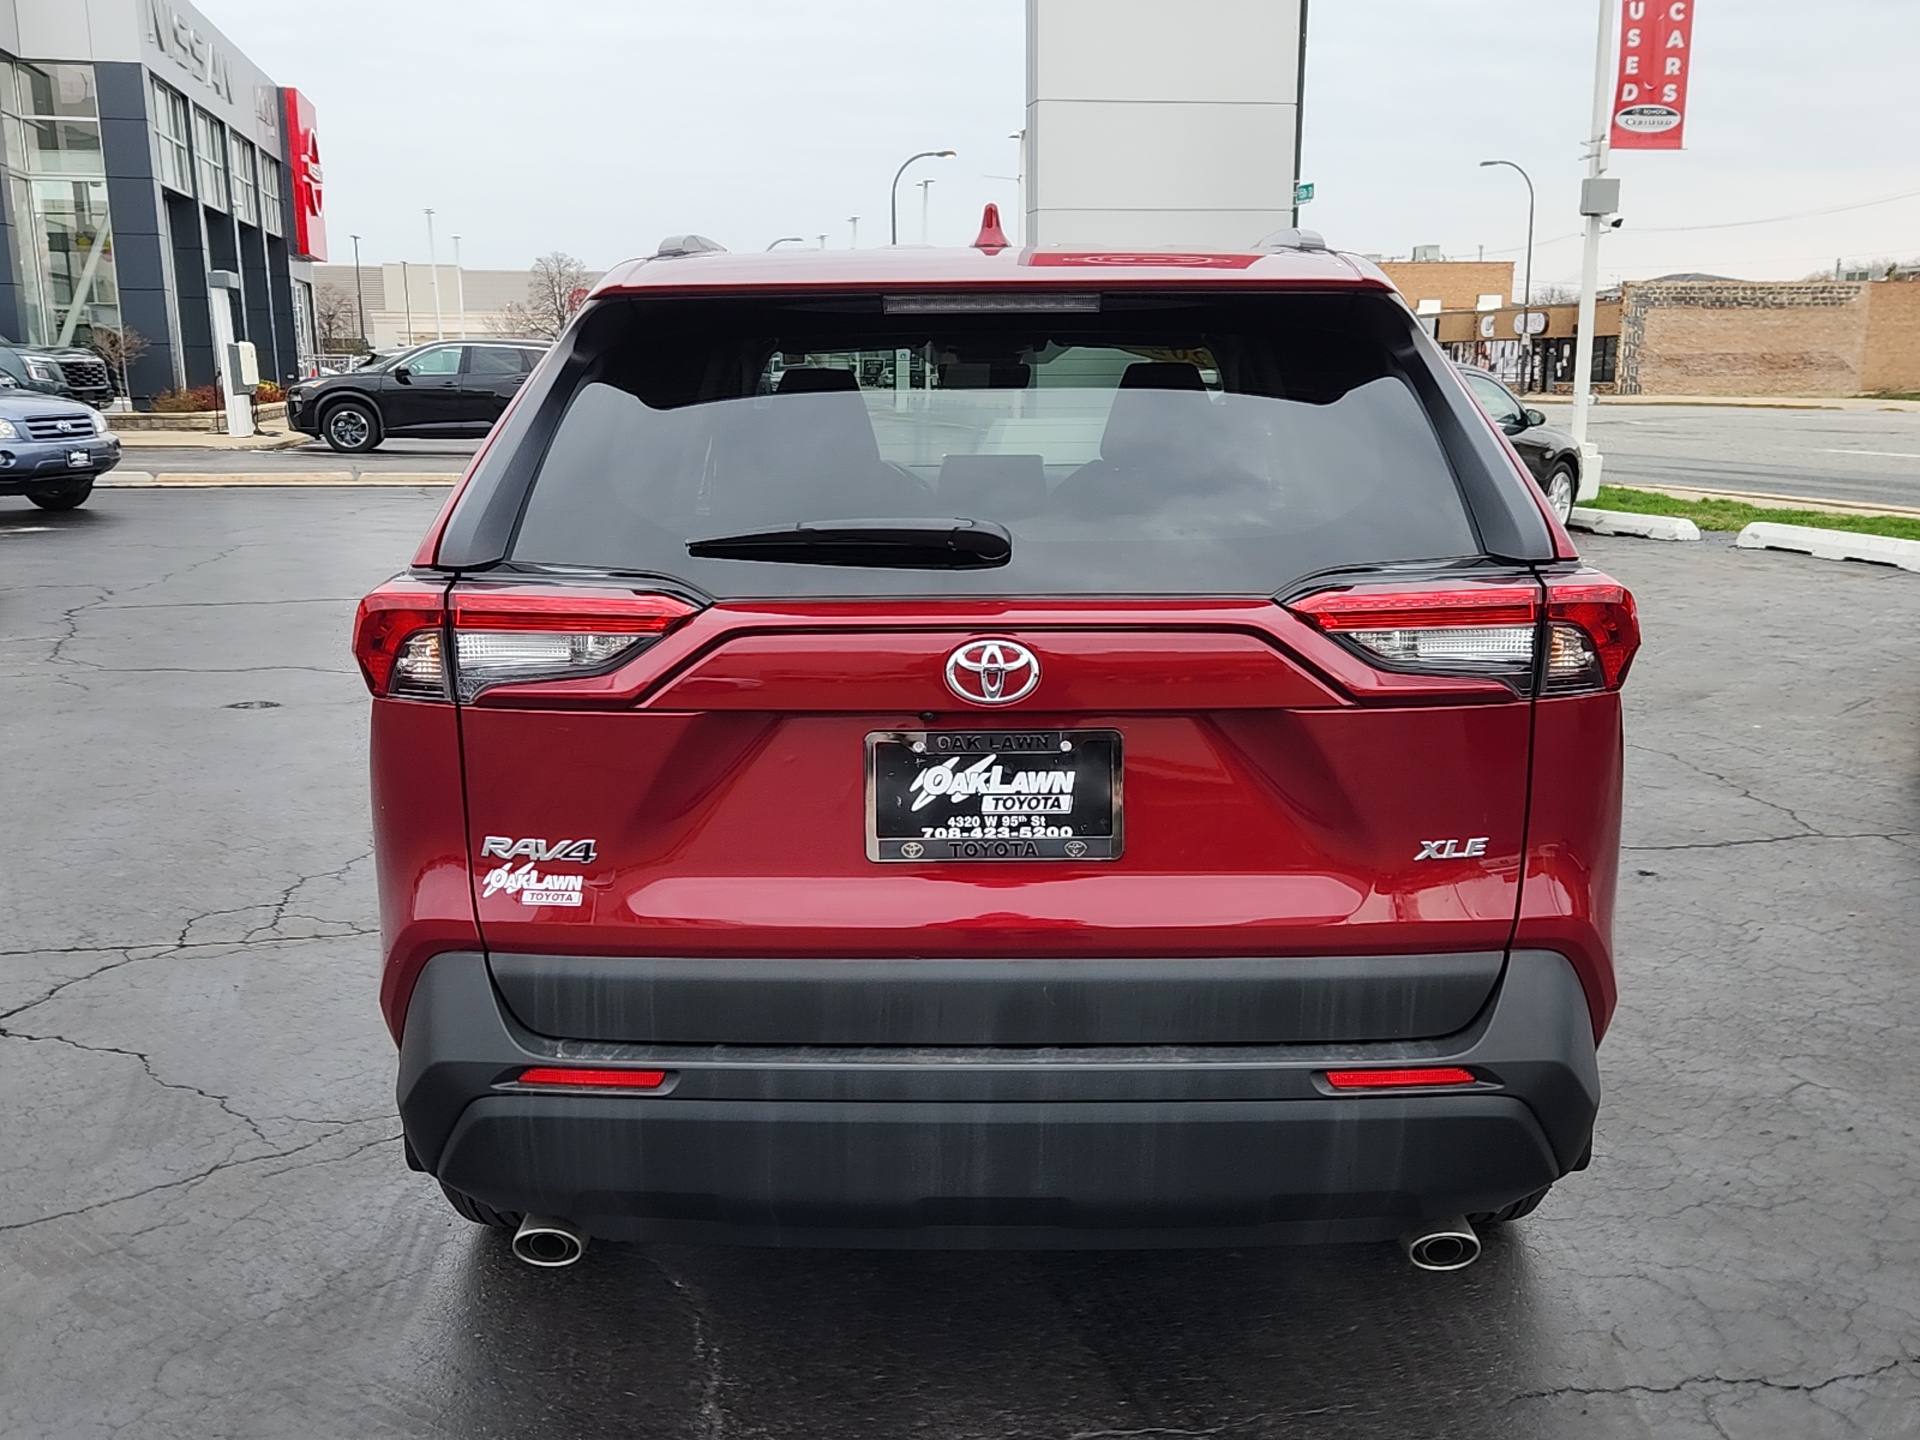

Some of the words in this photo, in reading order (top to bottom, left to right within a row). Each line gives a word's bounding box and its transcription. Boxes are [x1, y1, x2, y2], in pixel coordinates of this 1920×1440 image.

[144, 0, 234, 106] NISSAN
[1621, 0, 1646, 103] USED
[1662, 1, 1687, 103] CARS
[936, 735, 981, 751] OAK
[989, 735, 1049, 751] LAWN
[991, 796, 1063, 811] TOYOTA
[947, 815, 981, 828] 4320
[983, 815, 999, 828] W
[1001, 815, 1028, 828] 95th
[1030, 815, 1046, 827] St
[920, 827, 1074, 839] 708-423-5200
[481, 835, 598, 864] RAV4
[948, 841, 1040, 858] TOYOTA
[1413, 837, 1490, 861] XLE
[529, 892, 574, 902] TOYOTA
